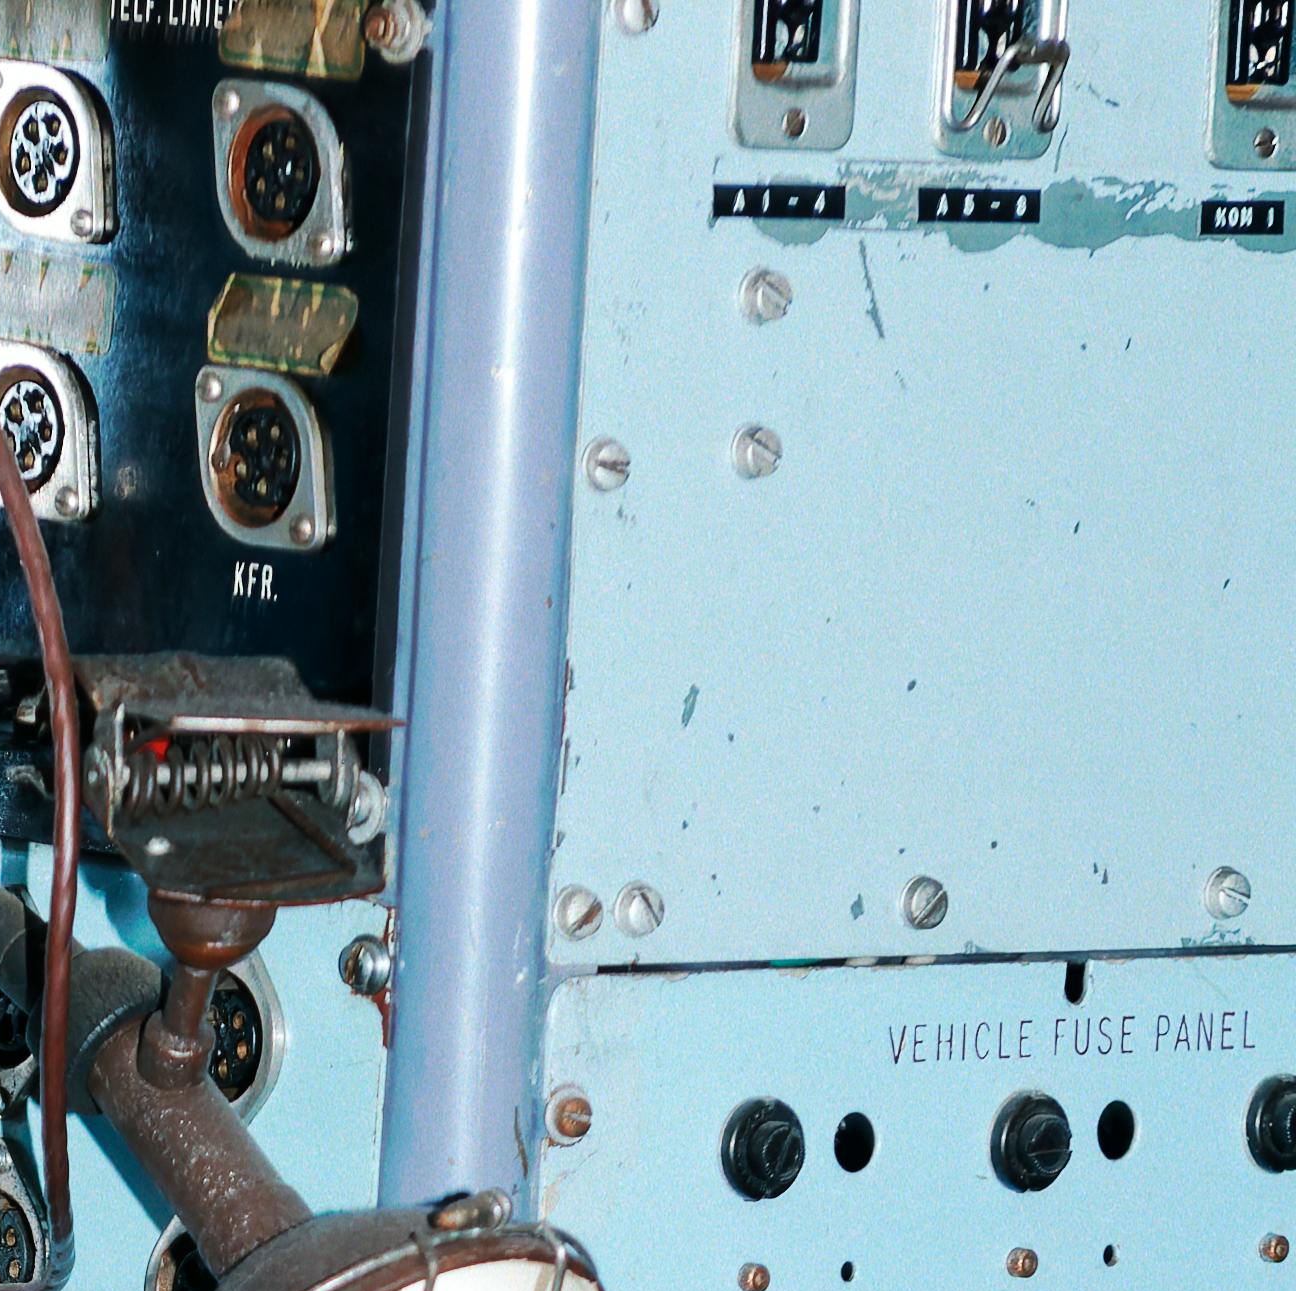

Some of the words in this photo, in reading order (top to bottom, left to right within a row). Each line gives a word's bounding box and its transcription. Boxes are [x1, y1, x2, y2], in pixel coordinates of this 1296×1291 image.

[169, 0, 233, 29] LINIE
[889, 1019, 1033, 1065] VEHICLE
[1054, 1015, 1136, 1056] FUSE
[1155, 1010, 1256, 1053] PANEL
